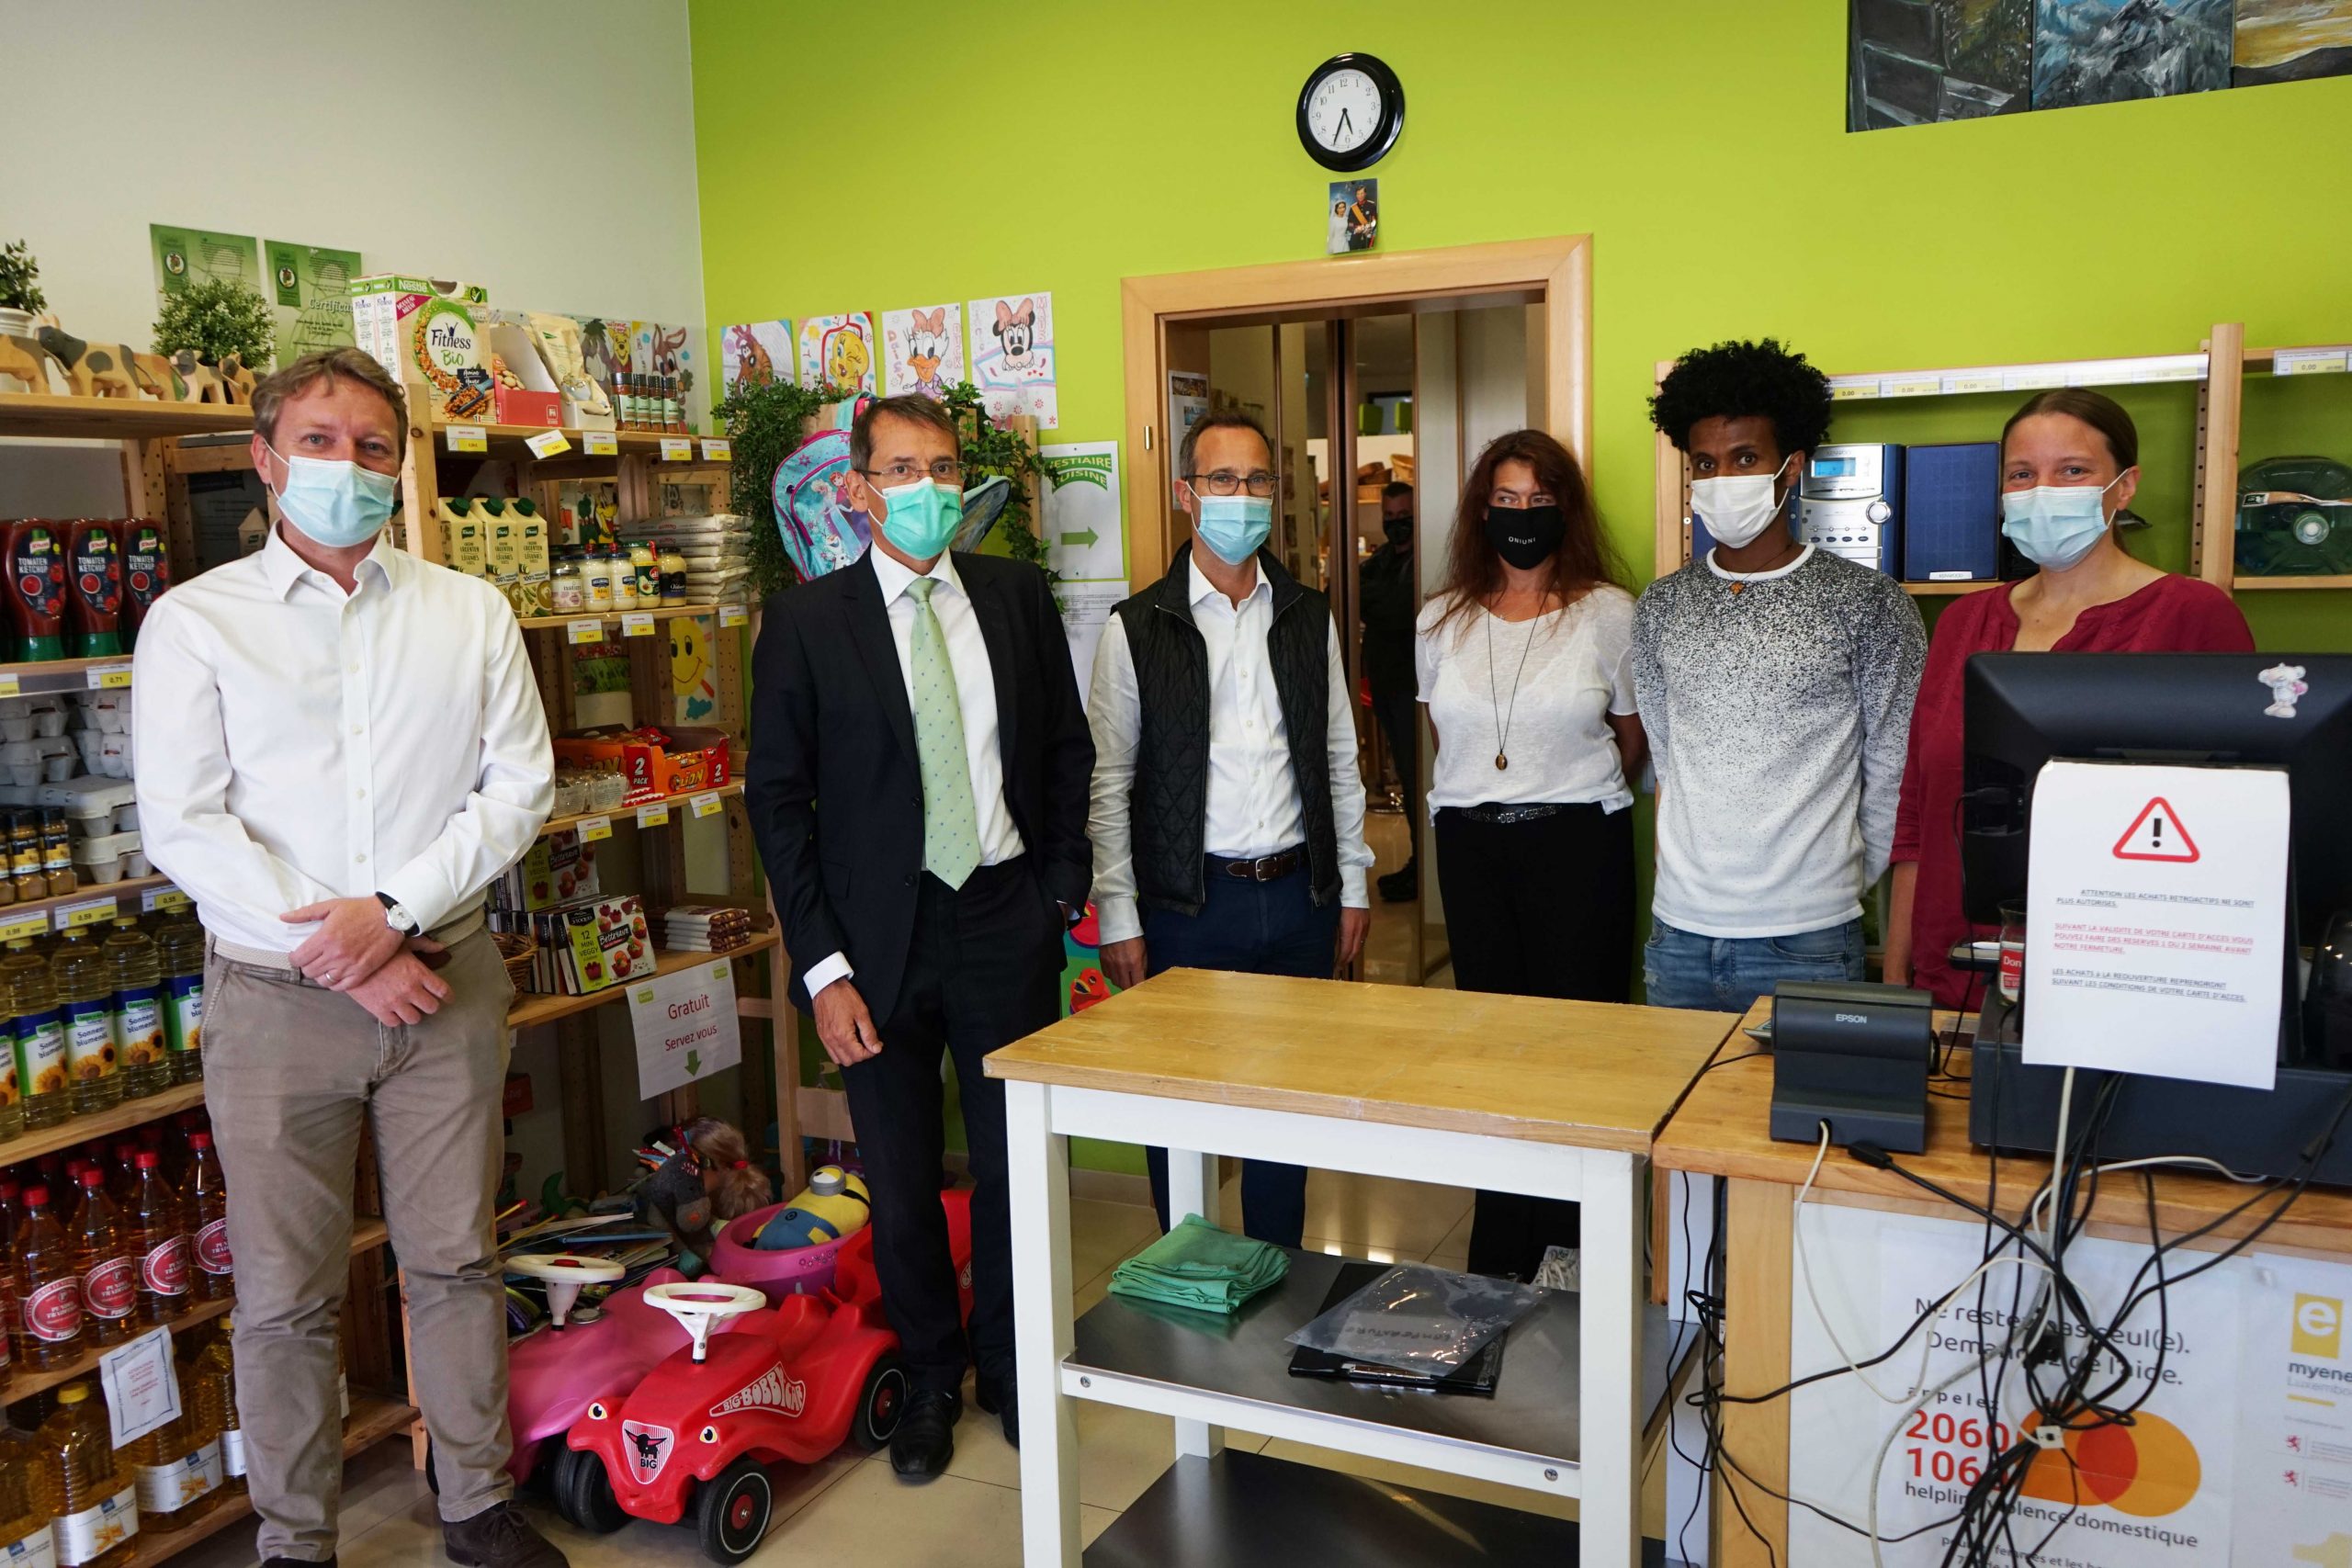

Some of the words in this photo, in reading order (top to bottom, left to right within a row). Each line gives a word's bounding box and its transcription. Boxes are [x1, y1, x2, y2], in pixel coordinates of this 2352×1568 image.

[1340, 78, 1348, 87] 12
[1355, 78, 1360, 87] 1
[1328, 85, 1335, 94] 11
[1365, 87, 1371, 96] 2
[1319, 96, 1328, 106] 10
[1371, 102, 1376, 110] 3
[1316, 112, 1321, 120] 9
[1367, 117, 1372, 125] 4
[1344, 134, 1351, 143] 6
[1358, 130, 1363, 139] 5
[431, 328, 471, 350] Fitness
[1054, 469, 1107, 488] UISINE
[1509, 536, 1536, 545] ONIUNI
[635, 757, 646, 776] 2
[715, 763, 722, 777] 2
[2081, 889, 2122, 897] ATTENTION
[2139, 893, 2167, 901] ACHATS
[2054, 922, 2086, 931] SUIVANT
[581, 930, 590, 940] 12
[579, 947, 597, 956] VEGGY
[668, 993, 710, 1020] Gratuit
[1835, 1013, 1868, 1024] EPSON
[665, 1033, 695, 1051] Servez
[696, 1025, 718, 1040] vous
[2298, 1301, 2337, 1337] e
[1905, 1409, 2010, 1452] 2060
[639, 1459, 658, 1470] BIG
[1906, 1448, 2008, 1491] 106
[2075, 1512, 2199, 1548] domestique
[2050, 1556, 2062, 1567] et
